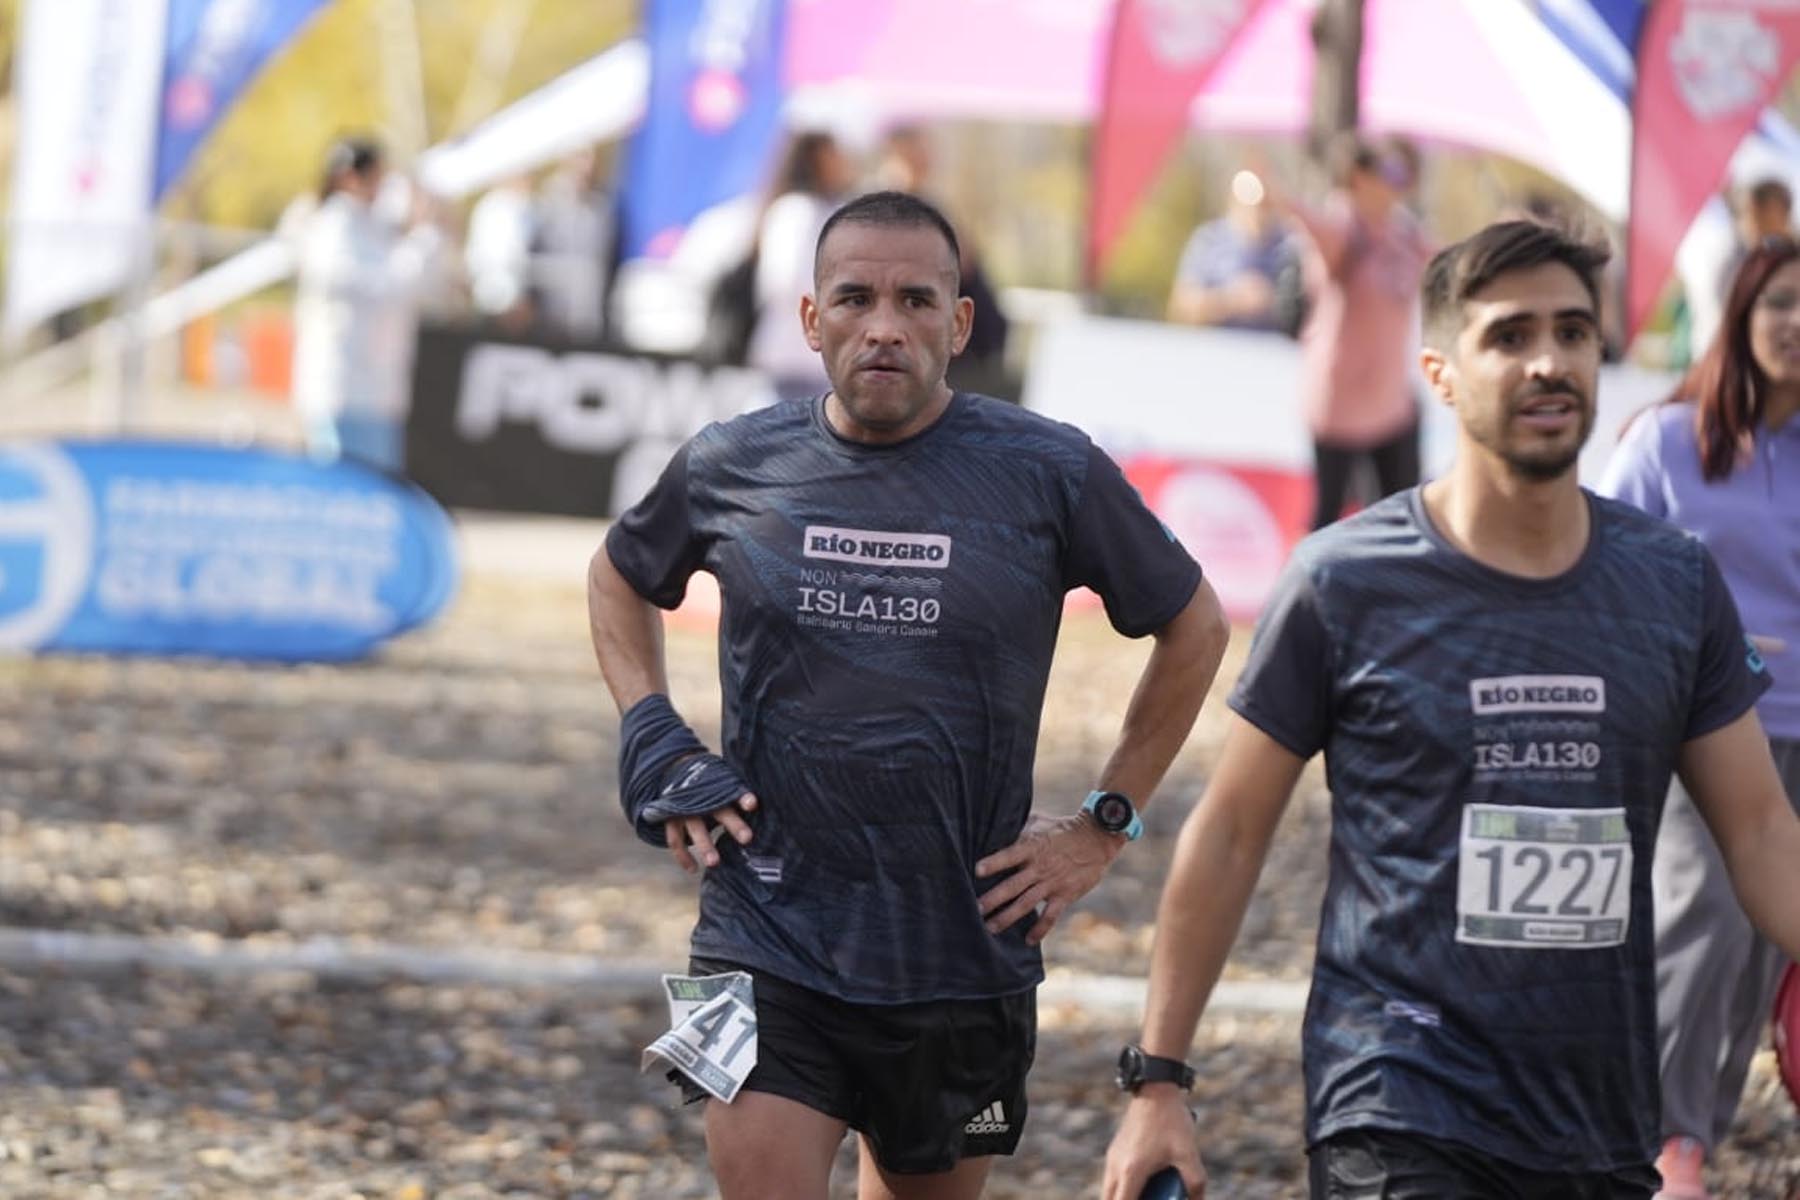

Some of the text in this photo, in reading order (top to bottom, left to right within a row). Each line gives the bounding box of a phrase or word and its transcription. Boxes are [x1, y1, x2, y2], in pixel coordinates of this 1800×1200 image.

[811, 533, 945, 562] RÍO NEGRO
[797, 587, 941, 623] ISLA130
[1523, 686, 1598, 704] NEGRO
[1474, 741, 1601, 769] ISLA130
[1476, 845, 1624, 916] 1227
[964, 1120, 1010, 1135] adidas
